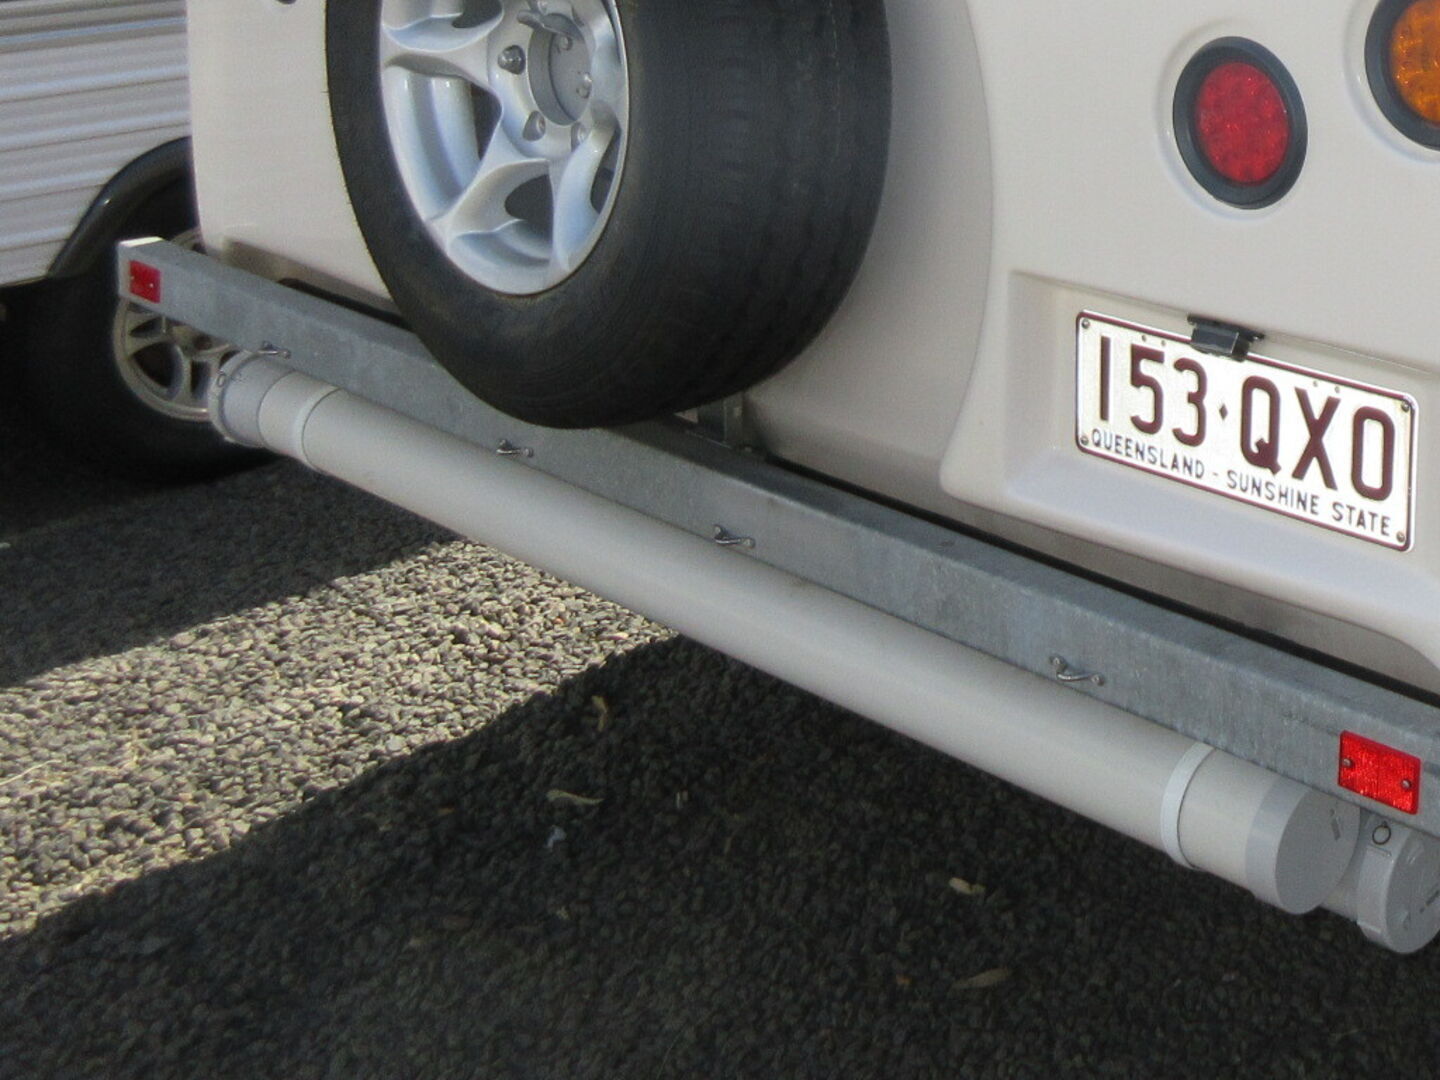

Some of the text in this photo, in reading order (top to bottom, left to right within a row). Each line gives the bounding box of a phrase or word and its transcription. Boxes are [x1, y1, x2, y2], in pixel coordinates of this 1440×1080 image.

[1091, 428, 1206, 479] QUEENSLAND
[1227, 469, 1320, 516] SUNSHINE
[1332, 501, 1391, 537] STATE
